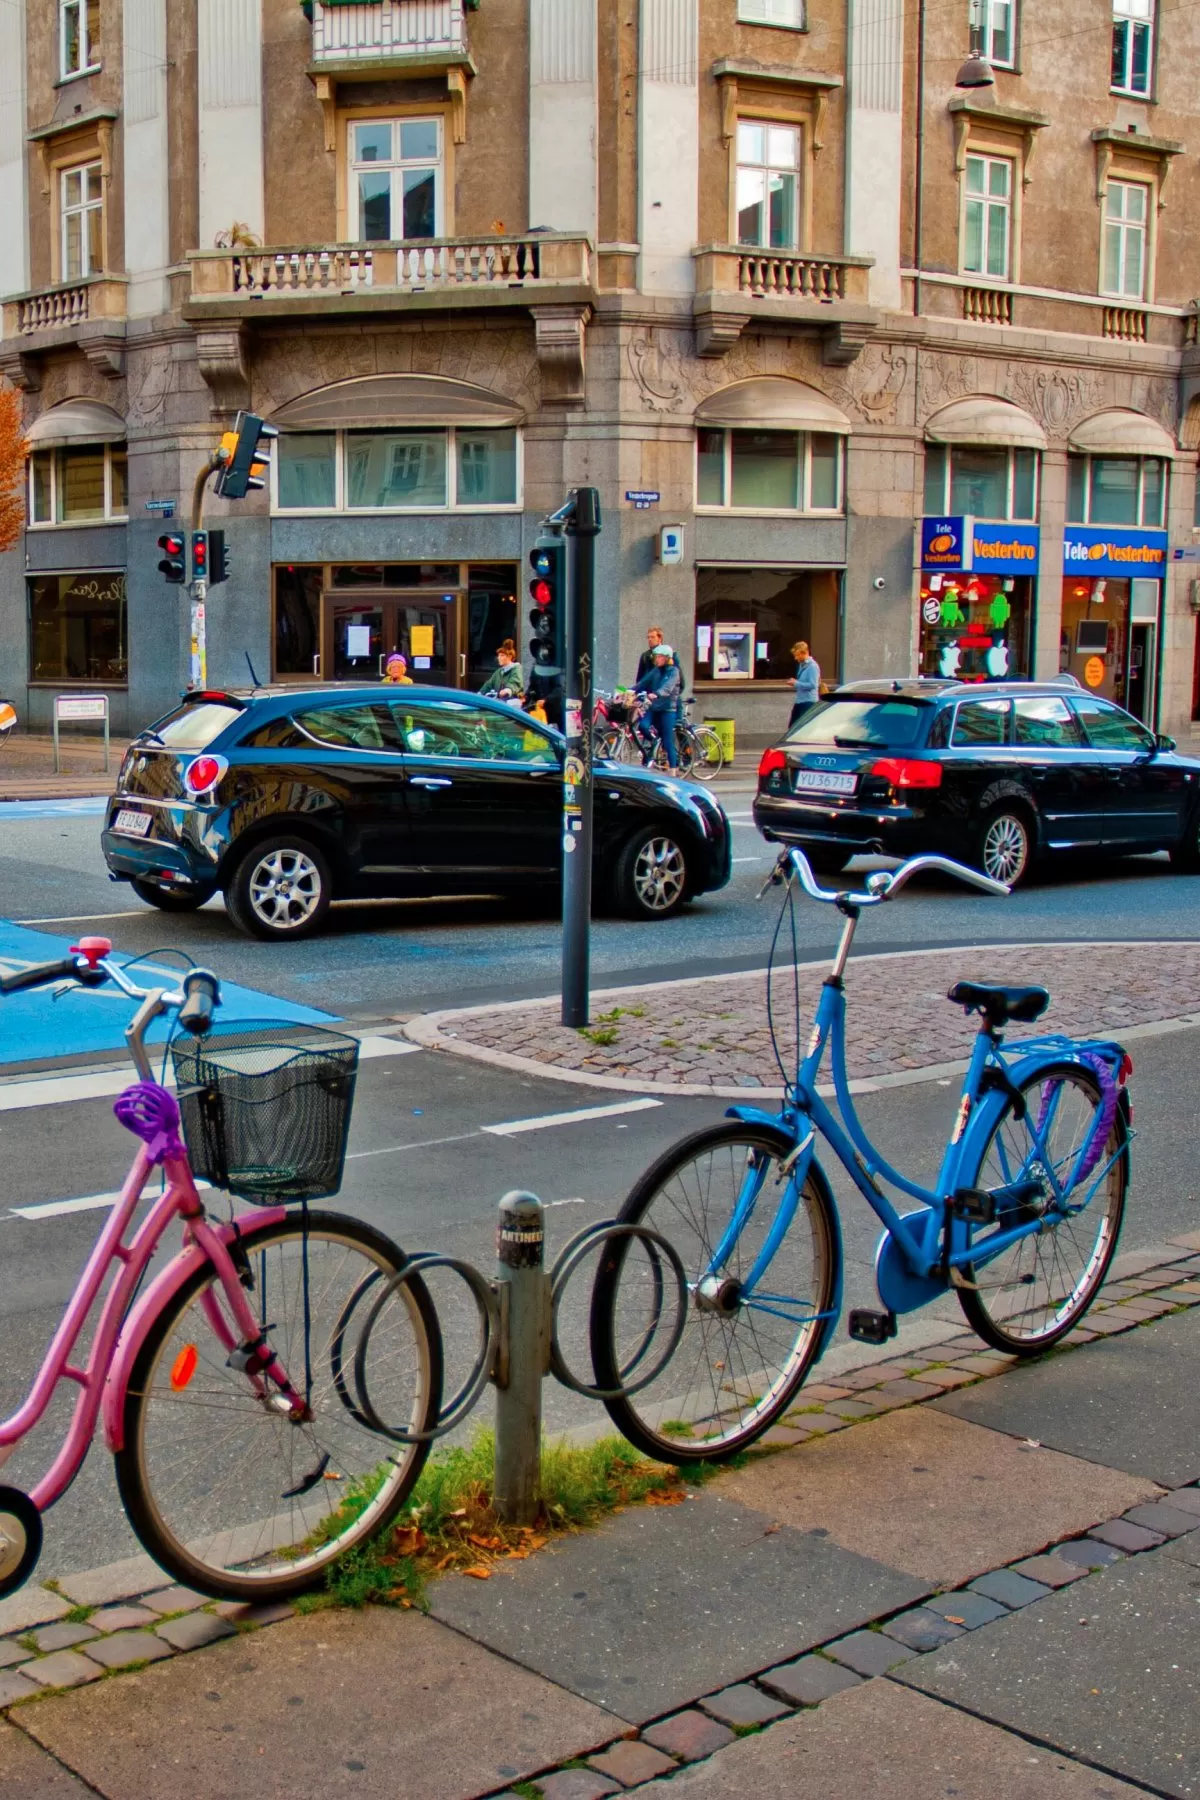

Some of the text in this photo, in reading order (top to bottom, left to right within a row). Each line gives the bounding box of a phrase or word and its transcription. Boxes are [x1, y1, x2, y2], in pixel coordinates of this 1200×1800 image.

[935, 523, 952, 533] Tele
[973, 538, 1036, 560] Vesterbro
[1063, 541, 1164, 563] Tele Vesterbro
[924, 554, 961, 563] Vesterbro
